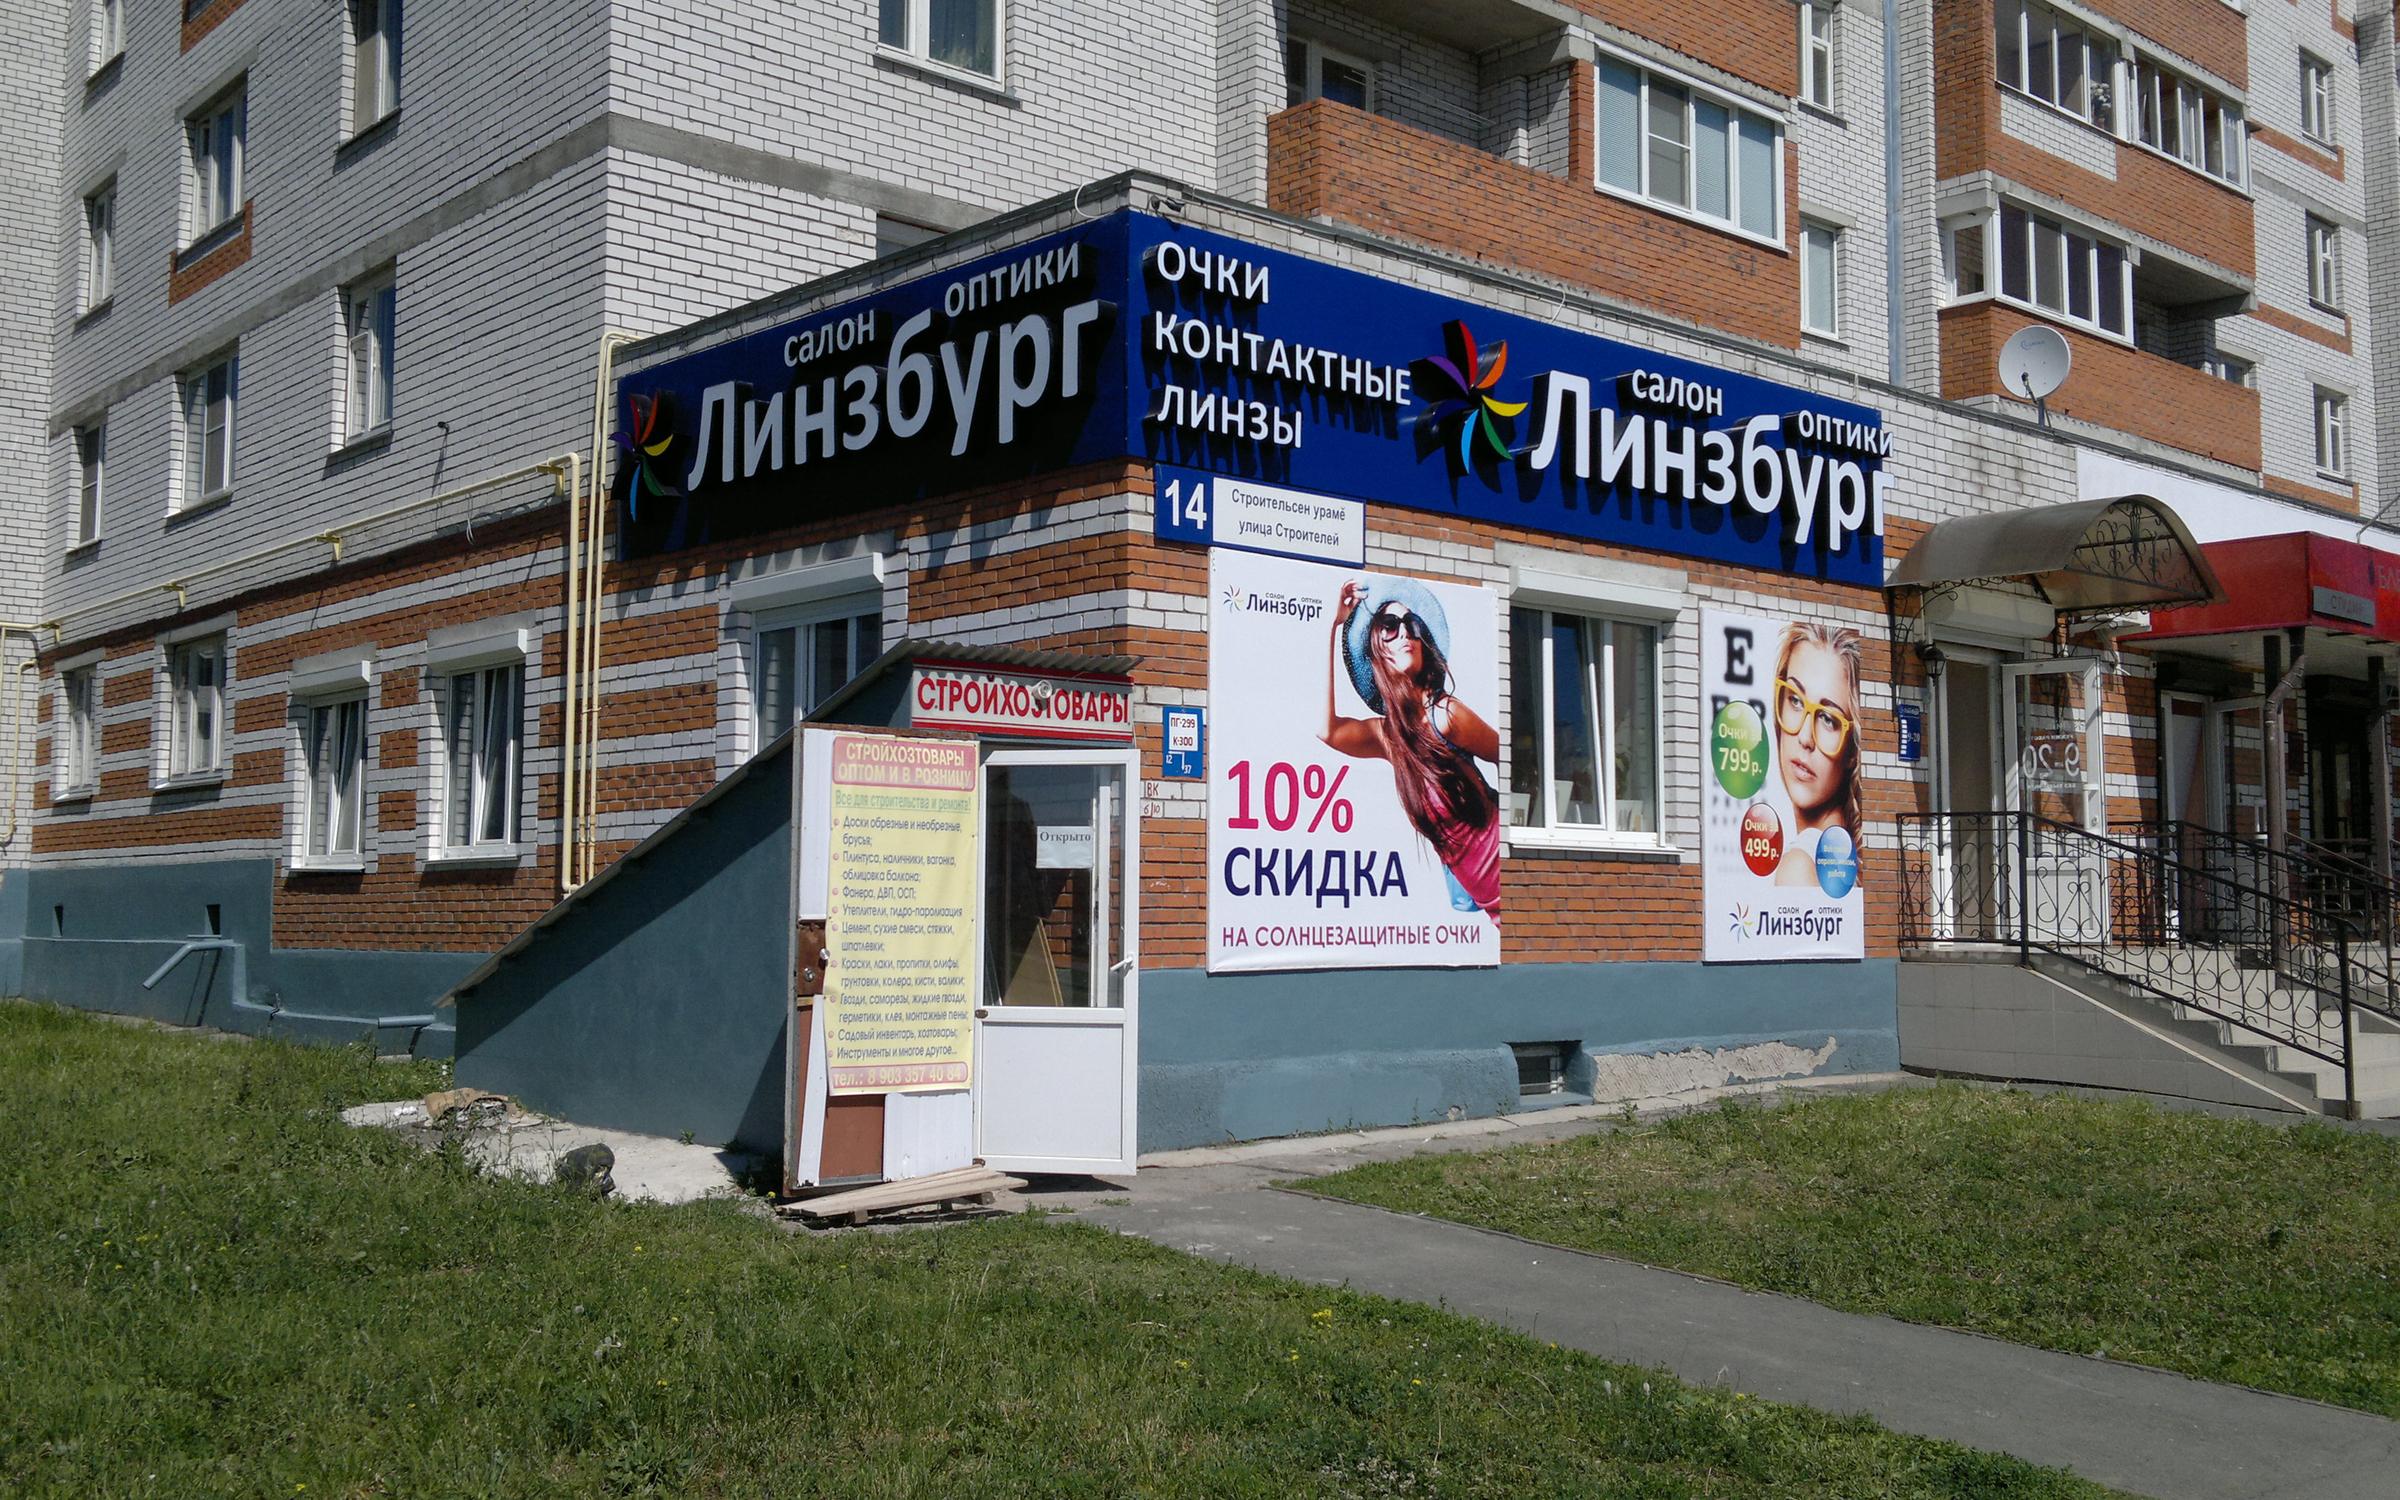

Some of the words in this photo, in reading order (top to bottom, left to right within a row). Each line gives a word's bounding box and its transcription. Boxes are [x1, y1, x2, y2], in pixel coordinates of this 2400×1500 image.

[1157, 241, 1269, 304] ОЧКИ
[784, 309, 875, 367] салон
[944, 241, 1080, 318] оптики
[1155, 311, 1411, 406] КОНТАКТНЫЕ
[688, 300, 1100, 492] Линзбург
[1157, 384, 1302, 448] ЛИНЗЫ
[1632, 368, 1723, 416] салон
[1799, 409, 1894, 458] оптики
[1531, 370, 1895, 551] Линзбург
[1165, 479, 1207, 530] 14
[1231, 488, 1311, 515] Строительсен
[1238, 519, 1273, 536] улица
[1275, 523, 1339, 546] Строителей
[1246, 593, 1323, 622] Линзбург
[1170, 717, 1196, 729] ПГ-299
[1719, 723, 1748, 740] Очки
[1173, 736, 1193, 747] К-300
[846, 741, 965, 767] СТРОЙХОЗТОВАРЫ
[1165, 754, 1173, 764] 12
[1719, 747, 1750, 772] 799
[1752, 762, 1762, 776] р.
[838, 762, 886, 780] ОПТОМ
[889, 764, 899, 782] И
[902, 766, 911, 783] В
[916, 767, 972, 789] РОЗНИЦУ
[1183, 764, 1193, 774] 37
[835, 789, 852, 805] Все
[871, 795, 930, 809] строительства
[1147, 782, 1159, 797] ВК
[1227, 760, 1354, 834] 10%
[843, 815, 869, 828] Доски
[870, 816, 908, 831] обрезные
[910, 821, 916, 830] и
[1745, 819, 1767, 832] Очки
[842, 832, 873, 848] брусья;
[1040, 831, 1091, 844] Открыто
[1745, 838, 1770, 857] 499
[1771, 848, 1779, 860] р.
[842, 868, 885, 882] облицовка
[886, 869, 921, 883] балкона;
[1224, 847, 1408, 909] СКИДКА
[1778, 906, 1799, 914] салон
[1818, 906, 1842, 914] оптики
[873, 924, 898, 936] сухие
[1756, 909, 1843, 941] Линзбург
[1222, 927, 1248, 947] НА
[1255, 925, 1430, 948] СОЛНЦЕЗАЩИТНЫЕ
[1435, 925, 1480, 945] ОЧКИ
[911, 993, 941, 1005] жидкие
[905, 1011, 948, 1022] монтажные
[837, 1028, 875, 1042] Садовый
[836, 1046, 891, 1061] Инструменты
[892, 1049, 898, 1058] и
[898, 1047, 925, 1058] многое
[832, 1072, 863, 1086] тел.:
[867, 1069, 875, 1085] 8
[879, 1067, 902, 1084] 903
[903, 1067, 925, 1084] 357
